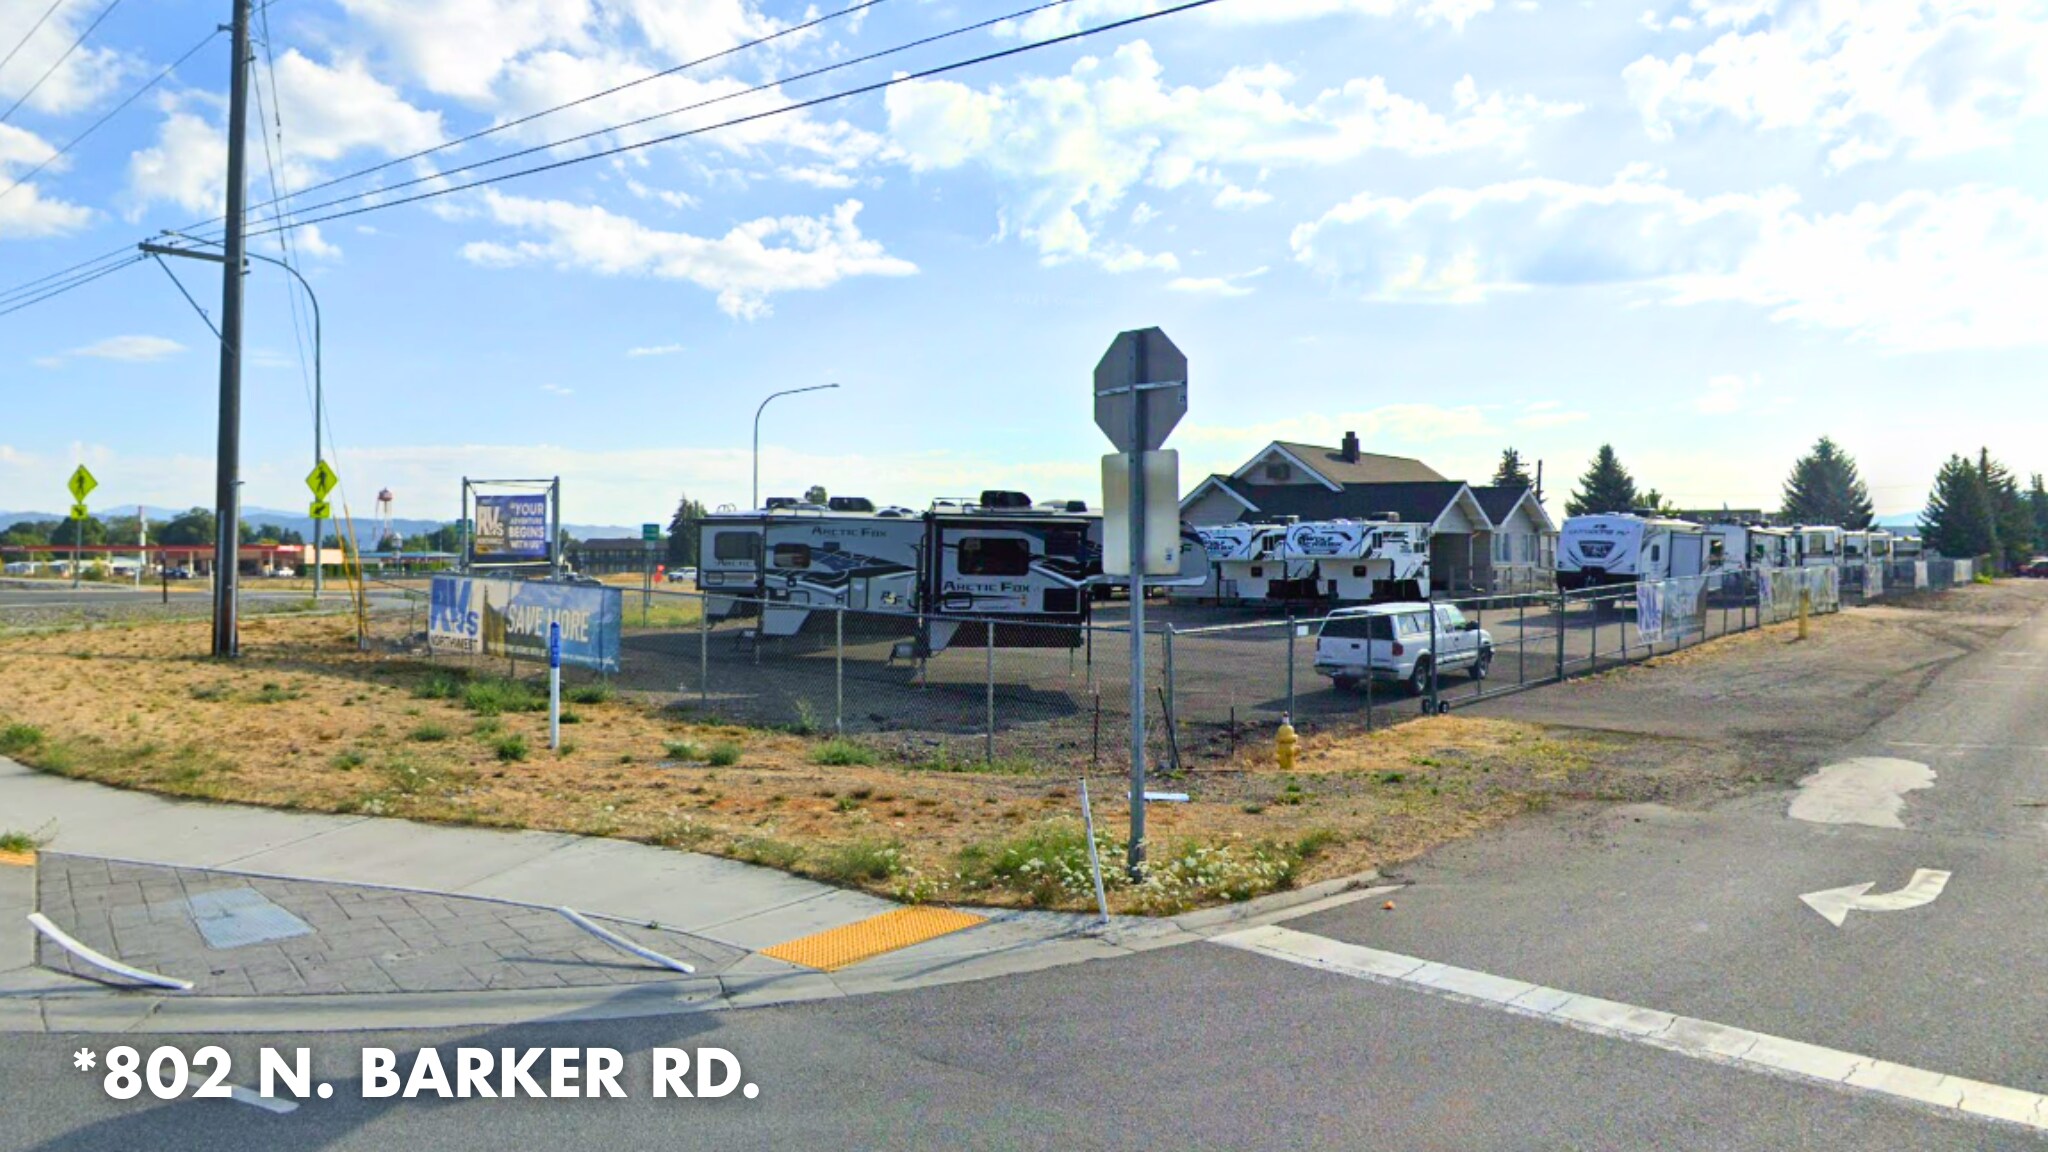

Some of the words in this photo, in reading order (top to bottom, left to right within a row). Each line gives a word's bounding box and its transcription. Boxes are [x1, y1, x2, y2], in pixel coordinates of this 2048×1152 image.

[509, 526, 544, 538] BEGINS
[943, 581, 997, 592] ARCTIC
[1001, 581, 1030, 593] FOX
[507, 604, 543, 636] SAVE
